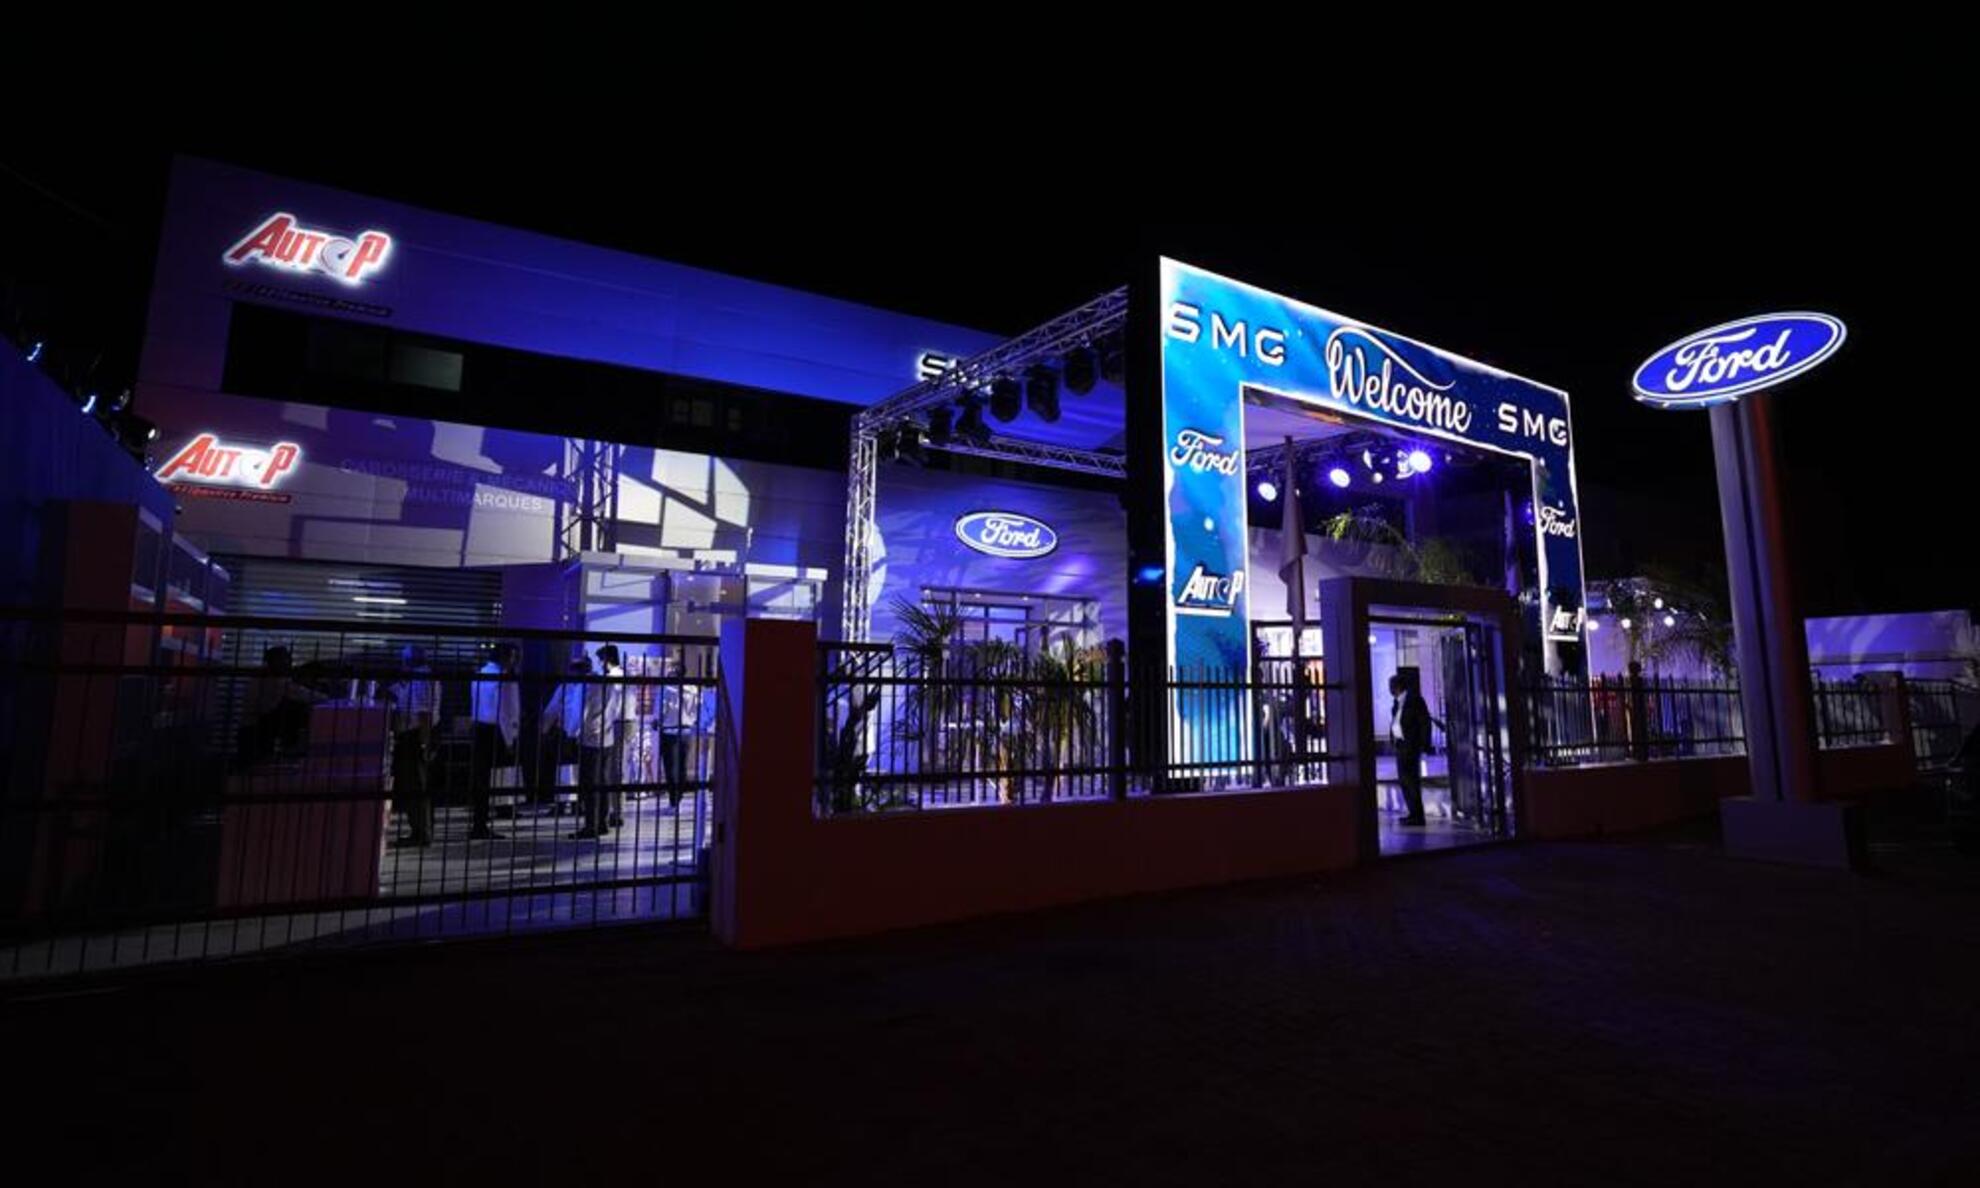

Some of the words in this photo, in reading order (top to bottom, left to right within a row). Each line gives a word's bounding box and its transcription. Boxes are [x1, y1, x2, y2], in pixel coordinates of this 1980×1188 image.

[1168, 300, 1285, 366] SMG
[1326, 327, 1472, 433] Welcome
[1666, 328, 1792, 391] Ford
[1498, 403, 1568, 446] SMG
[1171, 430, 1239, 475] Ford
[981, 518, 1040, 548] Ford
[1539, 506, 1575, 538] Ford
